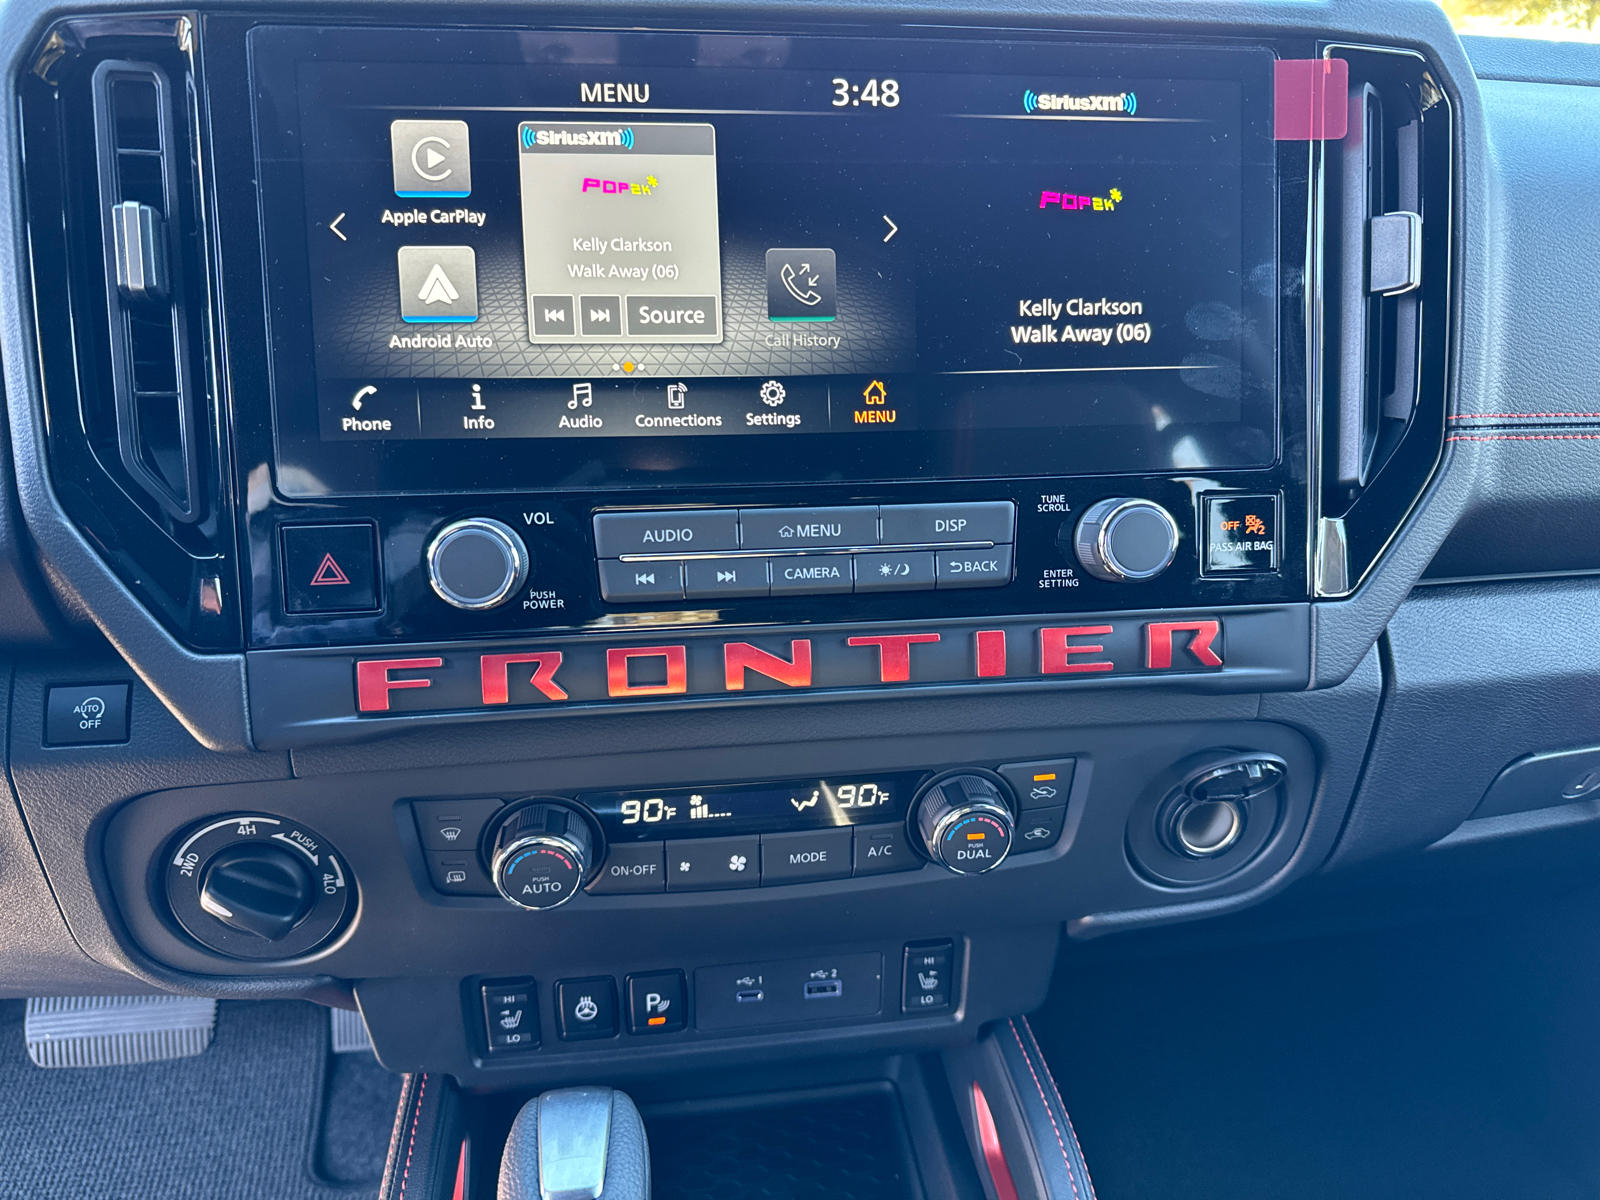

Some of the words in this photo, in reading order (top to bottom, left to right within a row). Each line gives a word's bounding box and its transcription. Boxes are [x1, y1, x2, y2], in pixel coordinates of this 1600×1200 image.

[581, 83, 650, 104] MENU
[832, 78, 900, 108] 3:48
[381, 209, 428, 227] Apple
[430, 209, 486, 227] CarPlay
[572, 237, 608, 255] Kelly
[610, 237, 672, 252] Clarkson
[567, 263, 605, 278] Walk
[608, 265, 650, 281] Away
[651, 264, 680, 280] (06)
[638, 306, 705, 325] Source
[1019, 298, 1063, 321] Kelly
[1066, 298, 1143, 316] Clarkson
[1010, 325, 1058, 344] Walk
[1061, 325, 1113, 346] Away
[1116, 322, 1151, 344] (06)
[388, 334, 452, 349] Android
[454, 335, 493, 349] Auto
[764, 334, 791, 347] Call
[793, 334, 841, 349] History
[463, 415, 495, 430] Info
[558, 414, 603, 429] Audio
[635, 413, 722, 428] Connections
[746, 412, 801, 429] Settings
[854, 410, 896, 424] MENU
[342, 417, 392, 432] Phone
[1041, 494, 1065, 504] TUNE
[1037, 502, 1071, 513] SCROLL
[523, 512, 555, 525] VOL
[796, 523, 842, 538] MENU
[935, 519, 967, 533] DISP
[1220, 521, 1240, 531] OFF
[642, 528, 693, 543] AUDIO
[1210, 542, 1233, 552] PASS
[1235, 541, 1252, 551] AIR
[1253, 540, 1274, 551] BAG
[784, 567, 840, 580] CAMERA
[964, 560, 998, 574] BACK
[1043, 569, 1073, 579] ENTER
[1038, 578, 1079, 588] SETTING
[530, 590, 556, 600] PUSH
[523, 599, 565, 610] POWER
[356, 621, 1224, 712] FRONTIER
[73, 704, 99, 714] AUTO
[79, 719, 102, 730] OFF
[237, 824, 257, 836] 4H
[290, 830, 319, 852] PUSH
[789, 850, 827, 865] MODE
[867, 845, 893, 858] A/C
[957, 847, 992, 860] DUAL
[180, 852, 200, 877] 2WD
[322, 873, 337, 895] 4LO
[532, 875, 550, 883] PUSH
[521, 881, 562, 895] AUTO
[923, 957, 935, 965] HI
[757, 975, 763, 985] 1
[830, 968, 838, 978] 2
[503, 995, 515, 1004] HI
[920, 995, 934, 1004] LO
[506, 1034, 521, 1043] LO
